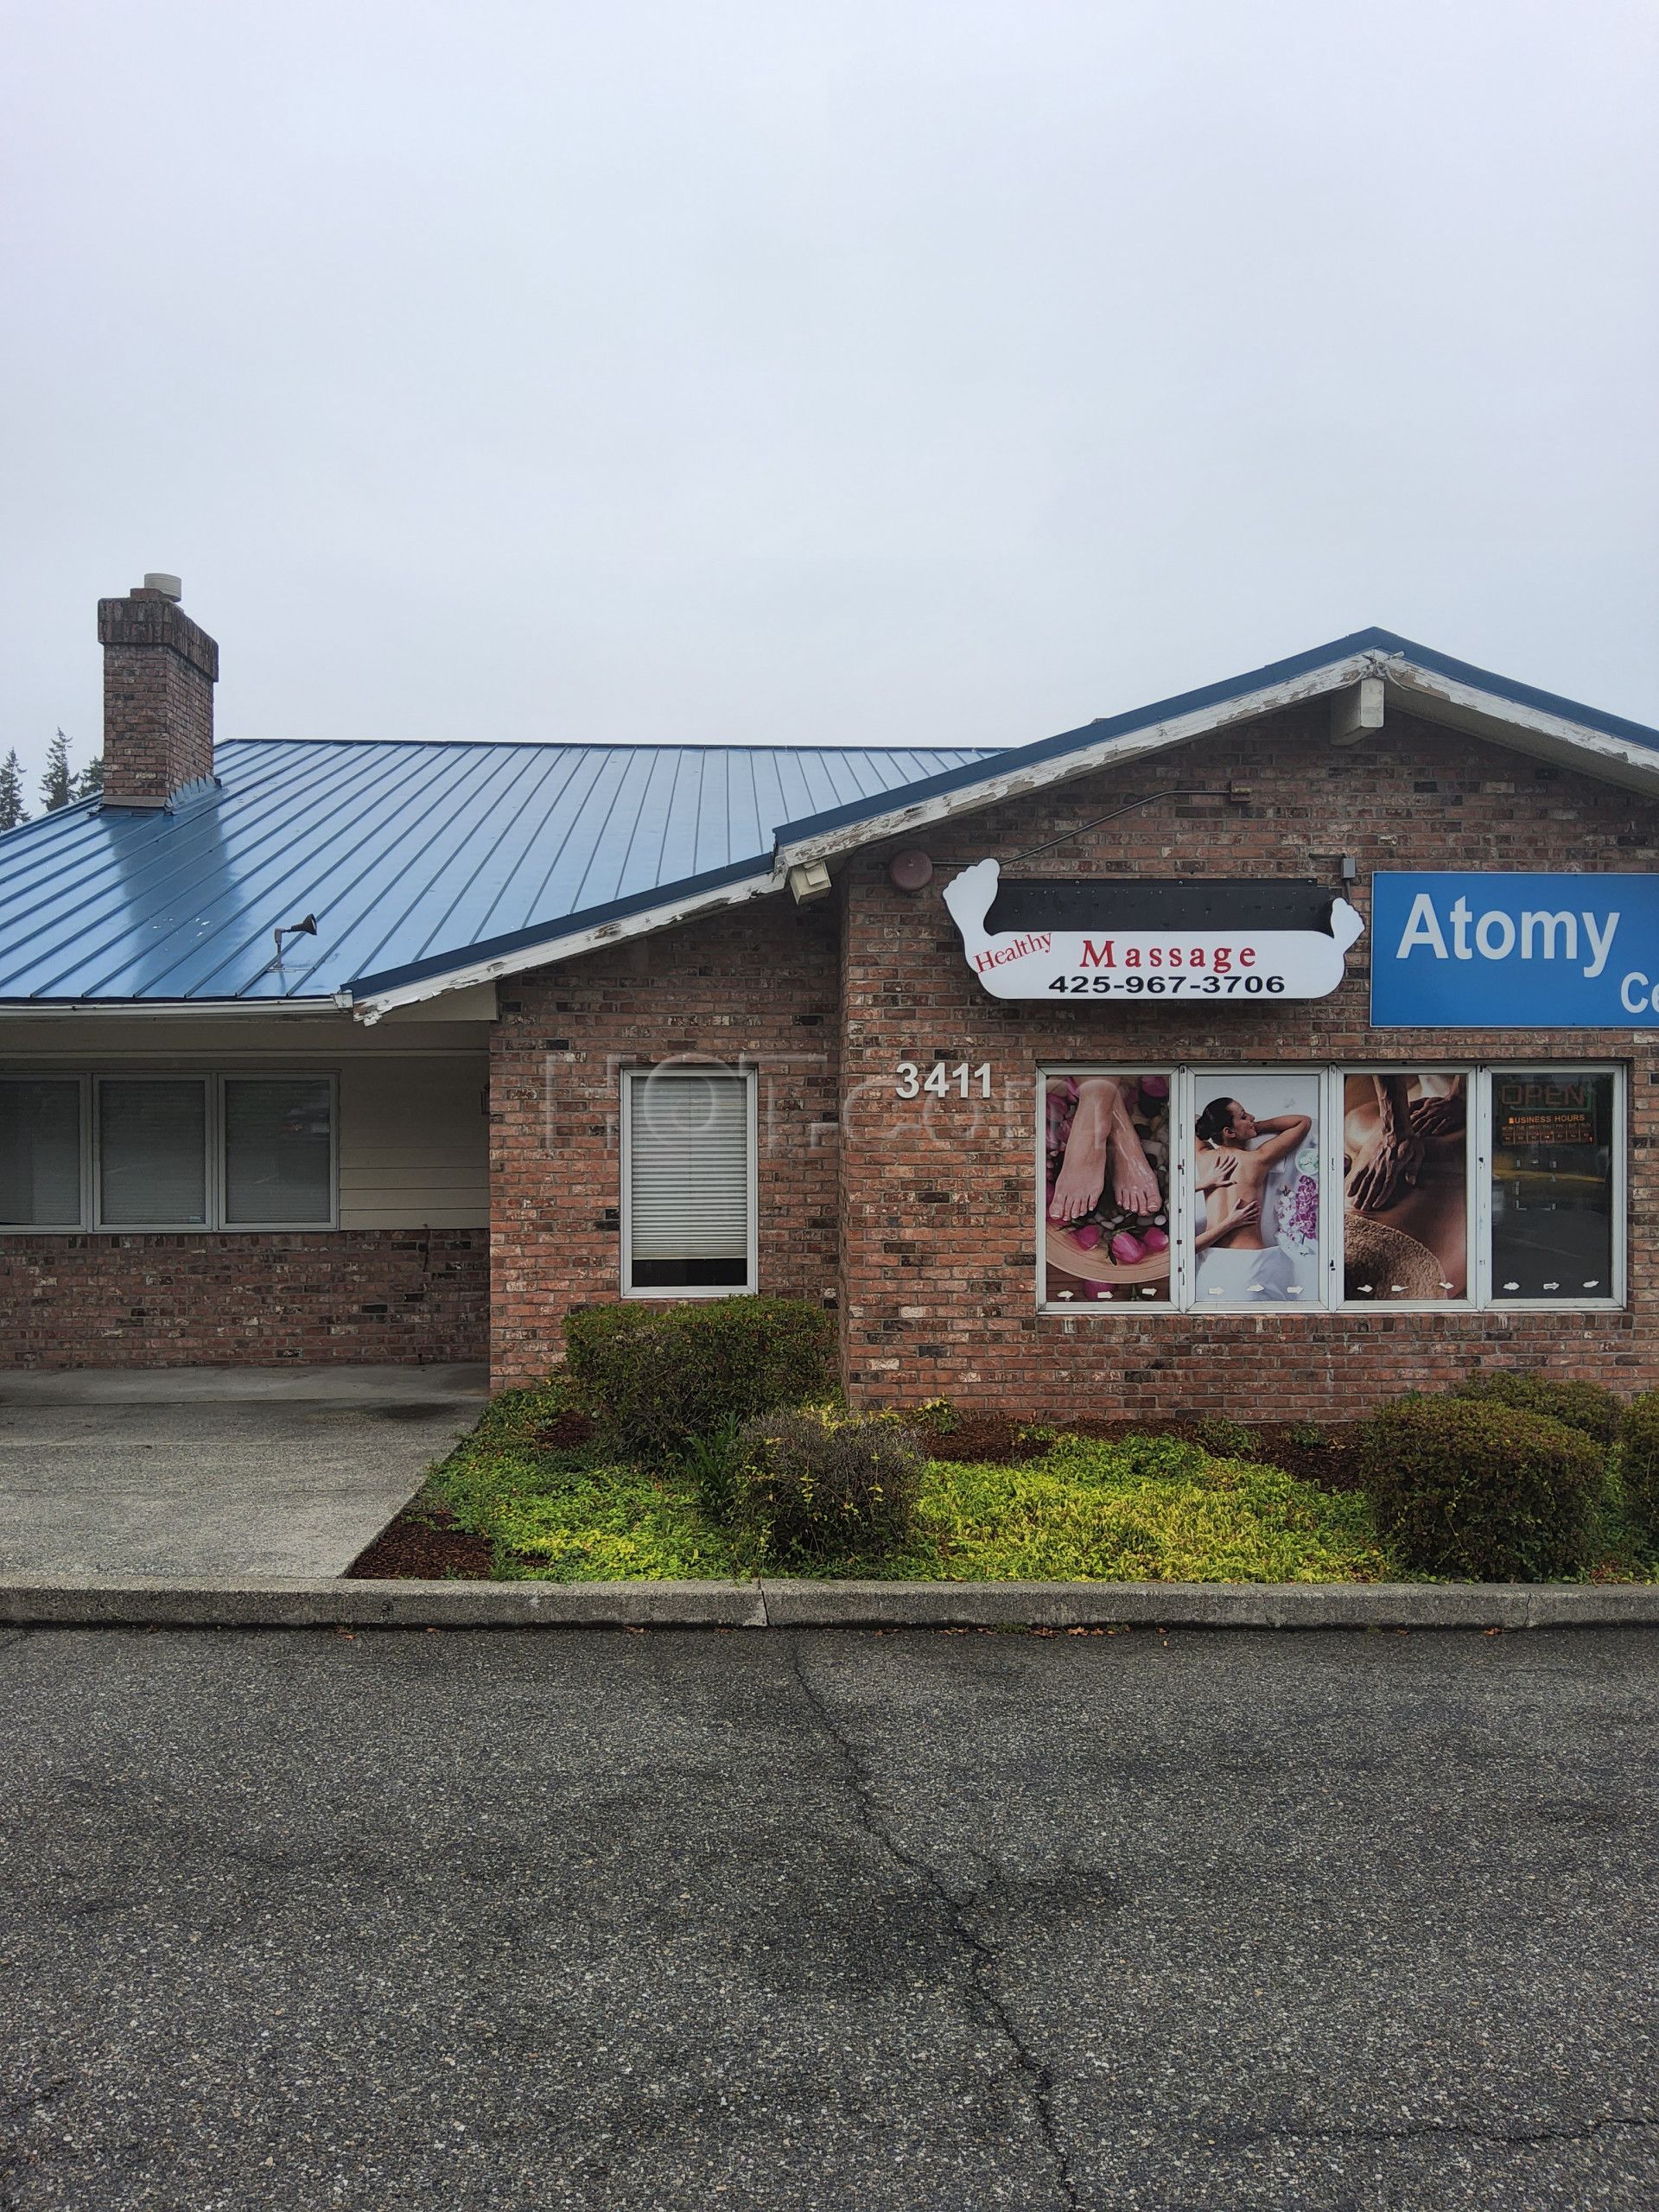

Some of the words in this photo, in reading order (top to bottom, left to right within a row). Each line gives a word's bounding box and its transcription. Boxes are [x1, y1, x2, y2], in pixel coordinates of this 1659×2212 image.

[1395, 893, 1621, 978] Atomy
[972, 931, 1053, 974] Healthy
[1079, 939, 1256, 974] Massage
[1048, 976, 1286, 995] 425-967-3706
[895, 1062, 991, 1099] 3411
[1502, 1084, 1586, 1106] OPEN
[1554, 1114, 1586, 1123] HOURS
